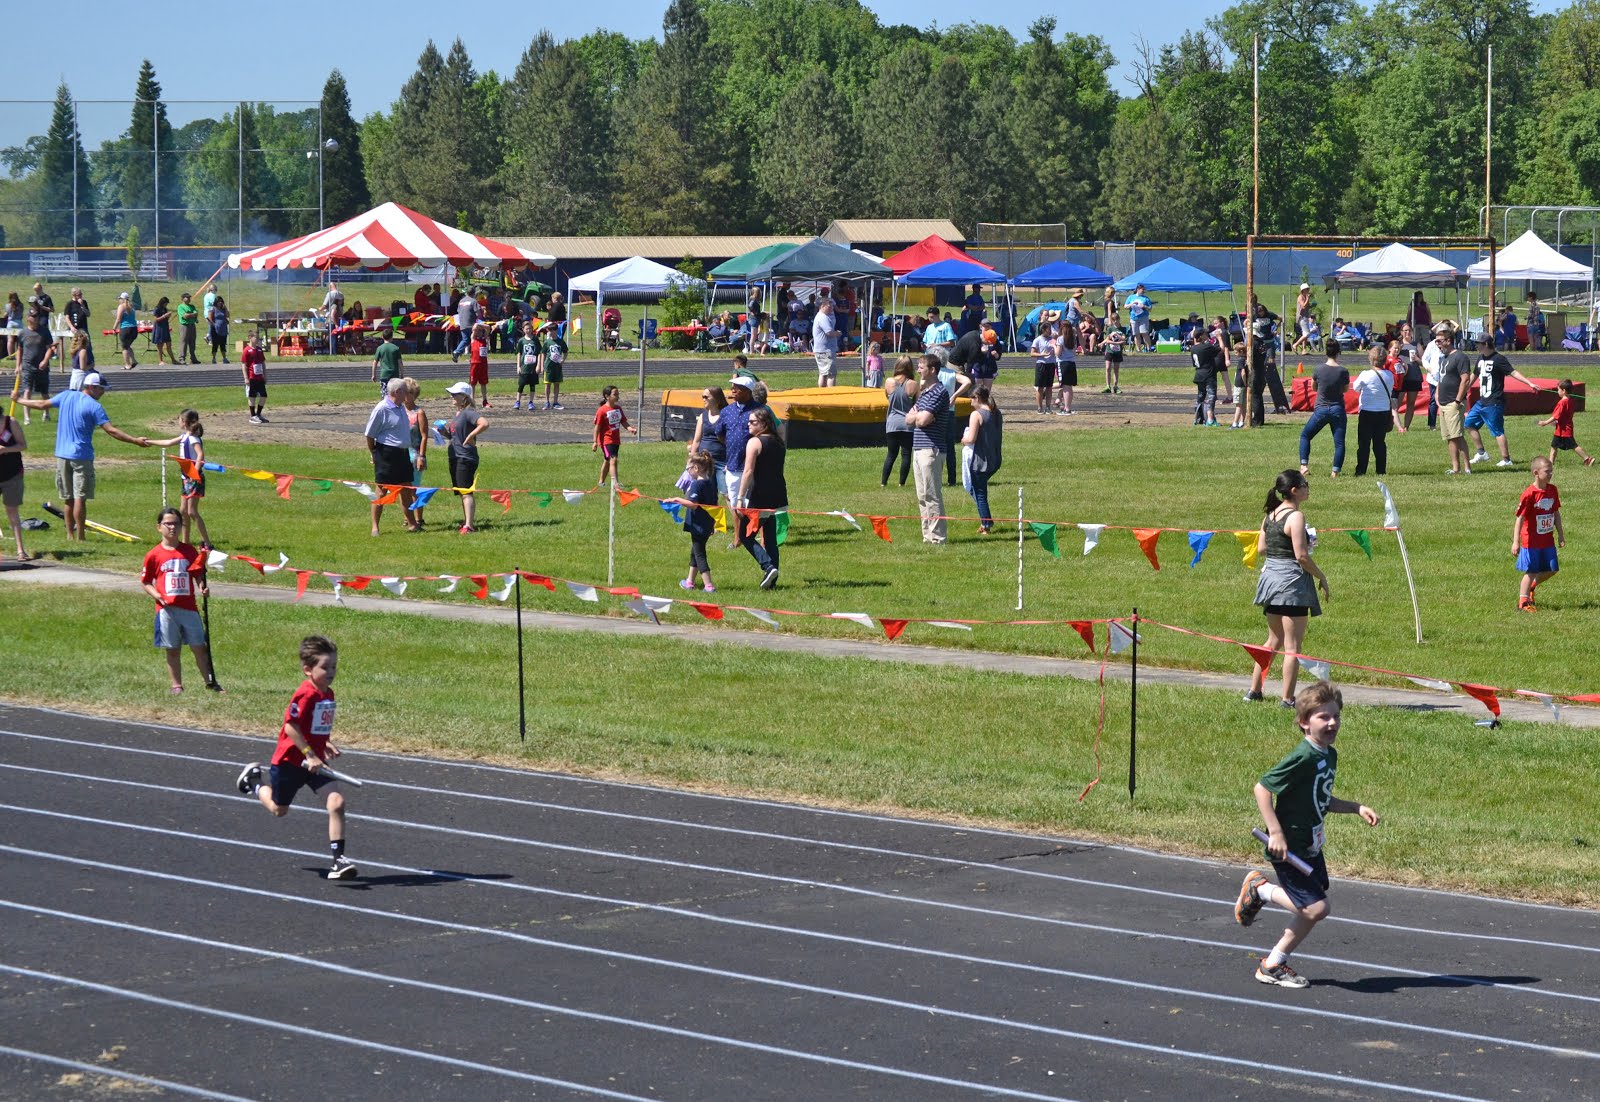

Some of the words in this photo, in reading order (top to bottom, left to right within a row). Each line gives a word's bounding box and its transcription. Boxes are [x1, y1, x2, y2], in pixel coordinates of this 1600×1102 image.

[1336, 249, 1353, 258] 400
[1541, 518, 1553, 529] 942
[171, 577, 186, 589] 910
